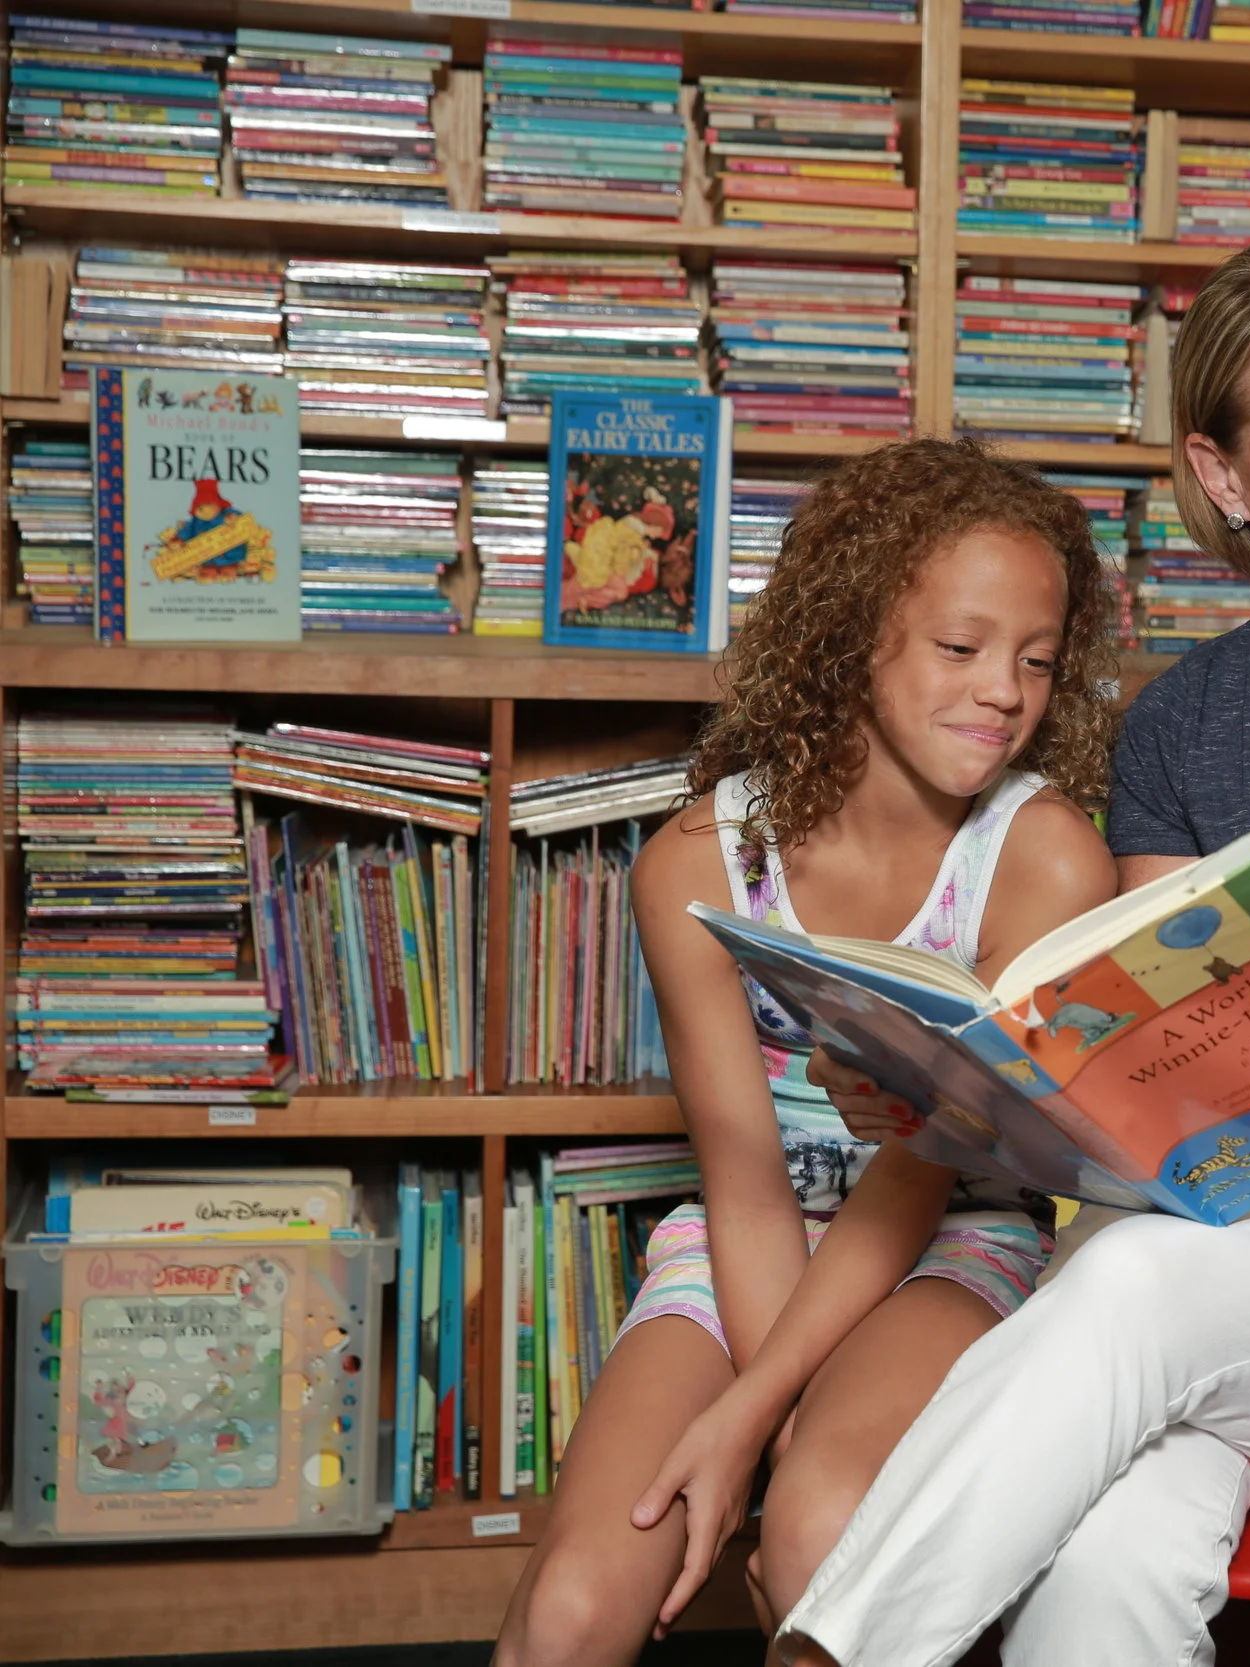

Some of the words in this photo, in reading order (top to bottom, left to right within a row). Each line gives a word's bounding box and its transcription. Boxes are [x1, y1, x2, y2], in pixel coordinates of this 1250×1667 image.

[620, 398, 654, 414] THE
[147, 414, 211, 430] Michael
[595, 411, 676, 431] CLASSIC
[566, 428, 630, 449] FAIRY
[633, 431, 705, 453] TALES
[148, 443, 271, 485] BEARS
[1163, 1028, 1184, 1048] A
